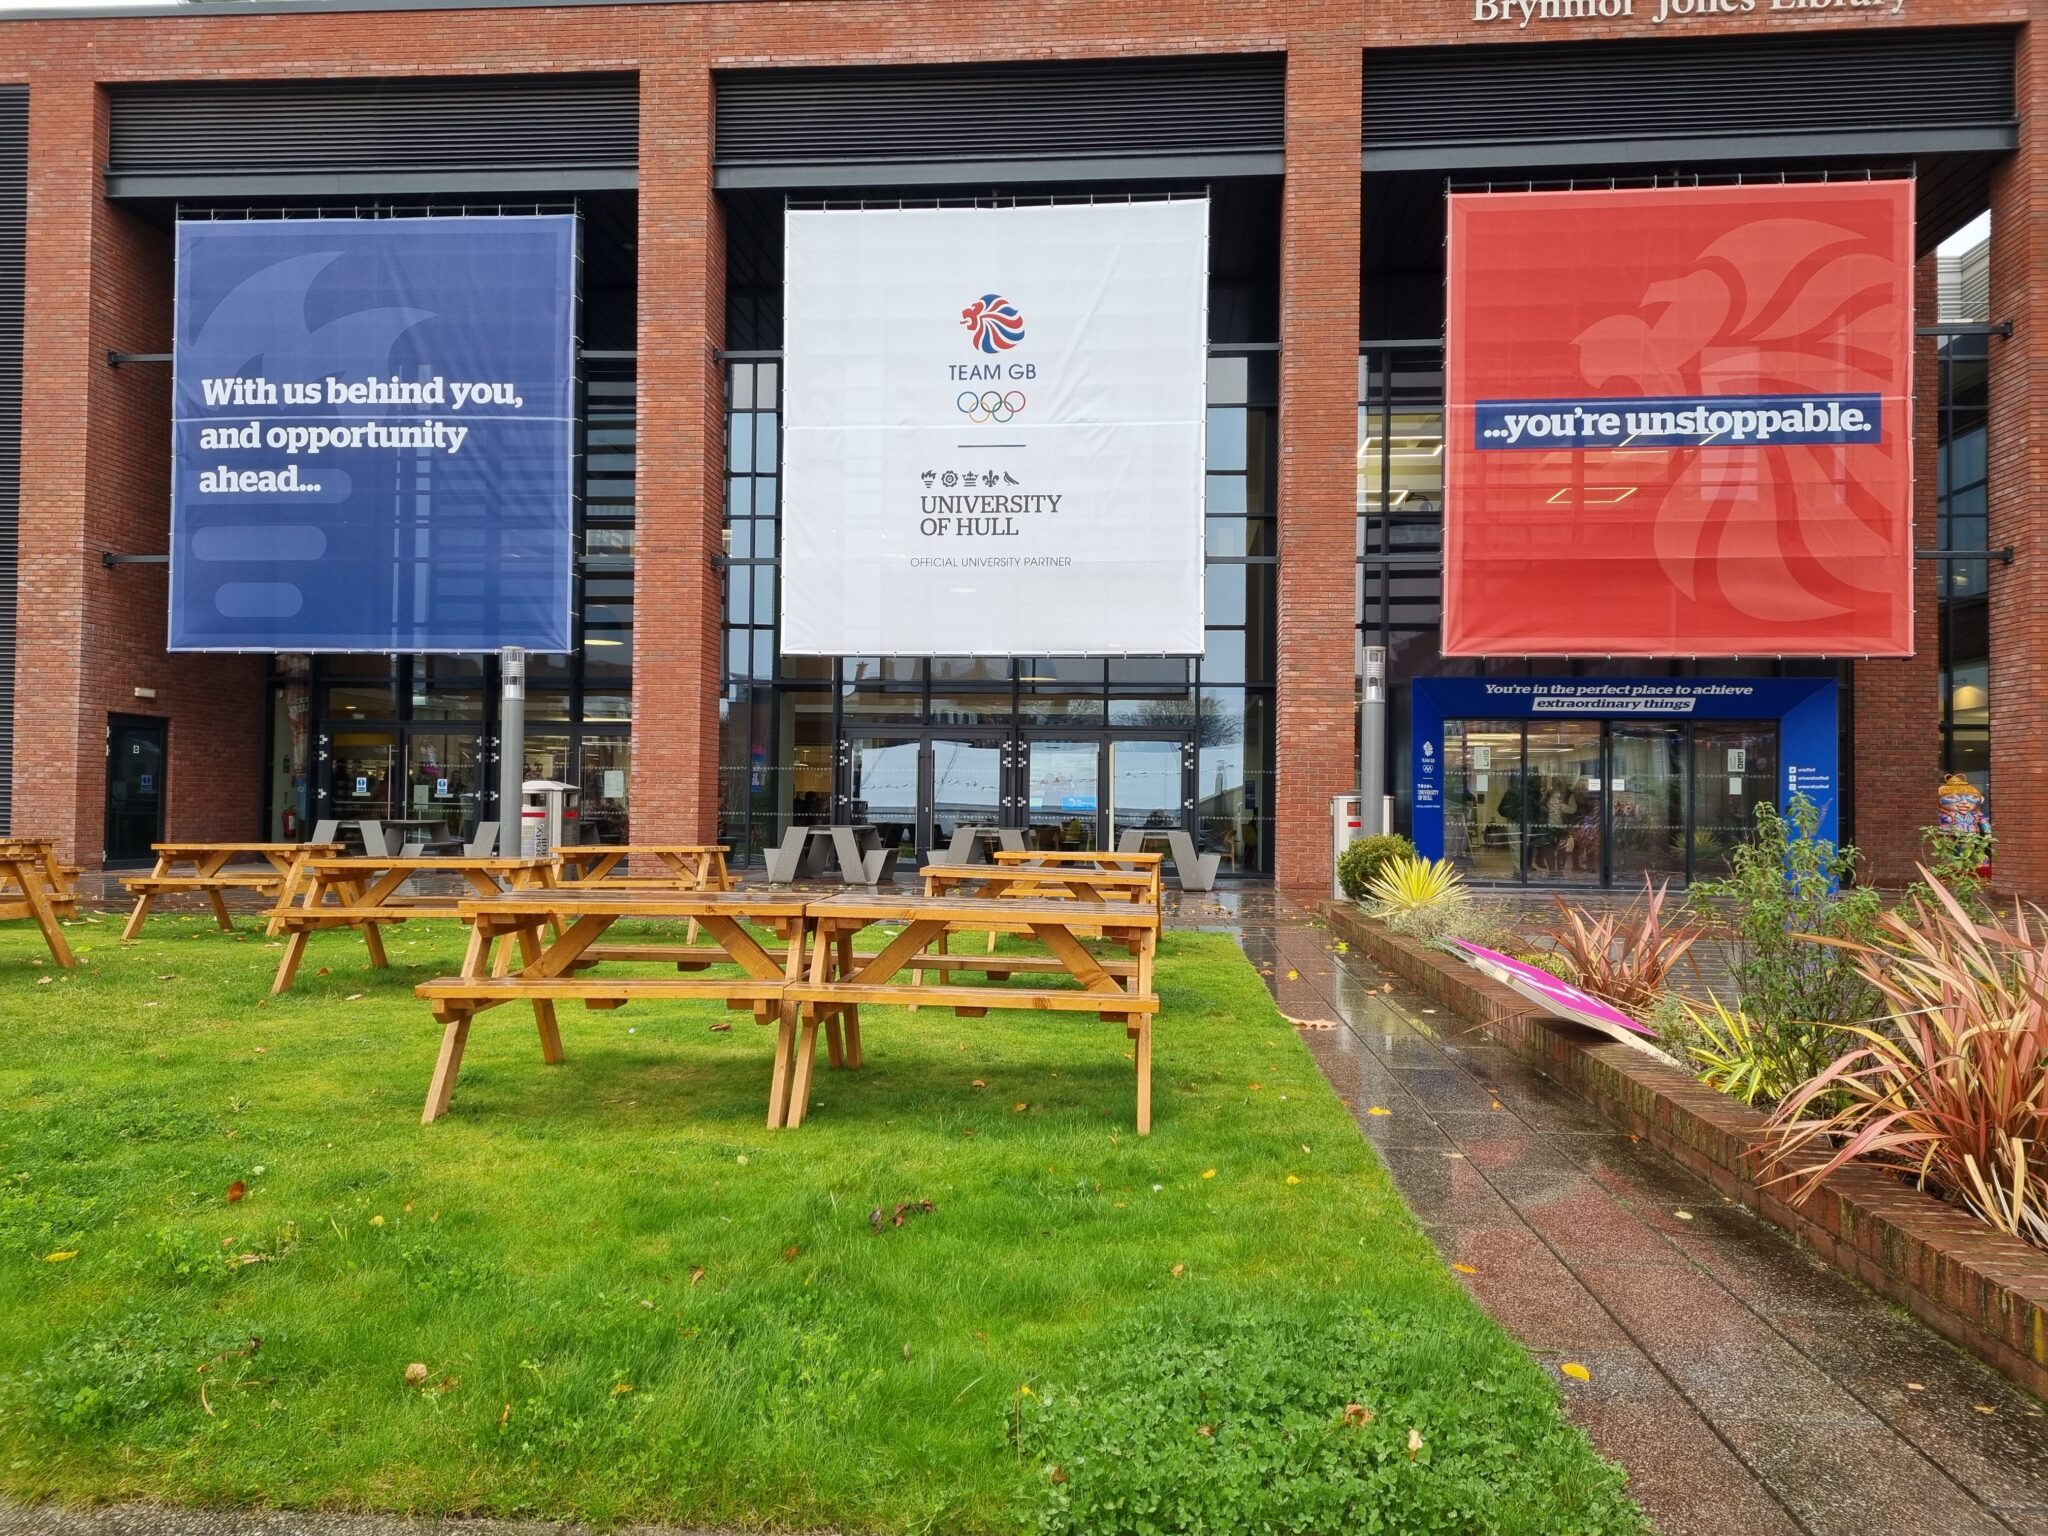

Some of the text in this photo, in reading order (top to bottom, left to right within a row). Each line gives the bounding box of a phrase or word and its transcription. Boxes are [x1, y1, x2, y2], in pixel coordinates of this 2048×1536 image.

[1472, 0, 1635, 29] Brynmor
[949, 363, 1037, 381] TEAM GB
[202, 376, 523, 410] With us behind you,
[1626, 402, 1872, 440] unstoppable.
[200, 420, 468, 453] and opportunity
[920, 494, 1063, 514] UNIVERSITY
[920, 517, 1019, 536] OF HULL
[910, 556, 1072, 567] OFFICIAL UNIVERSITY PARTNER
[1485, 684, 1753, 696] You're in the perfect place to achieve
[1537, 699, 1691, 710] extraordinary things
